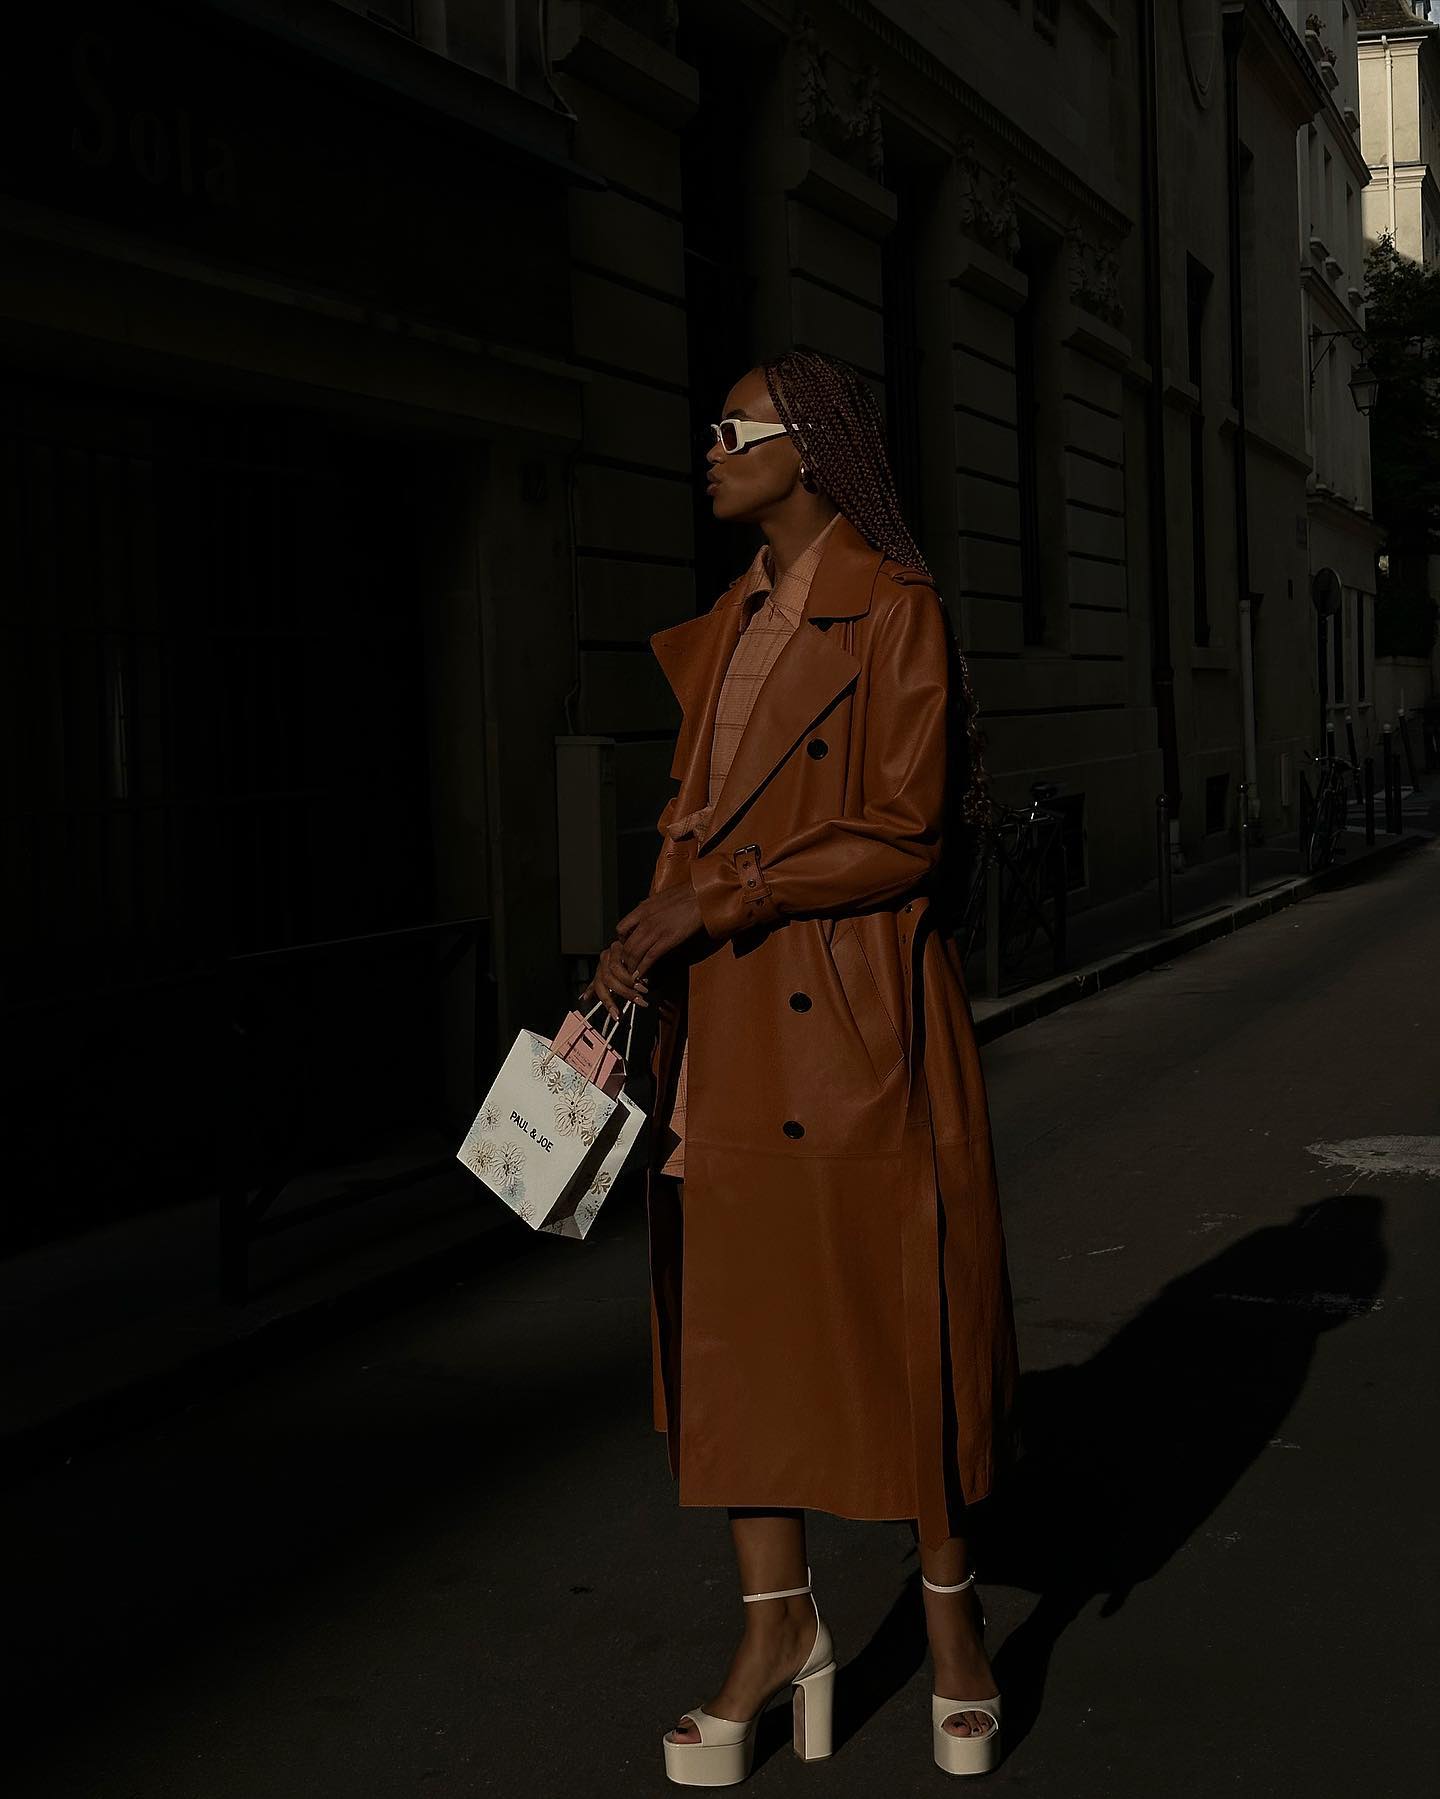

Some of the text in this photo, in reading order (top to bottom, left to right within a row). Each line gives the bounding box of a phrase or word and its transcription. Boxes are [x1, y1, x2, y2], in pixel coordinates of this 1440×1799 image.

[72, 32, 240, 208] Sola
[510, 1110, 554, 1153] PAUL & JOE
